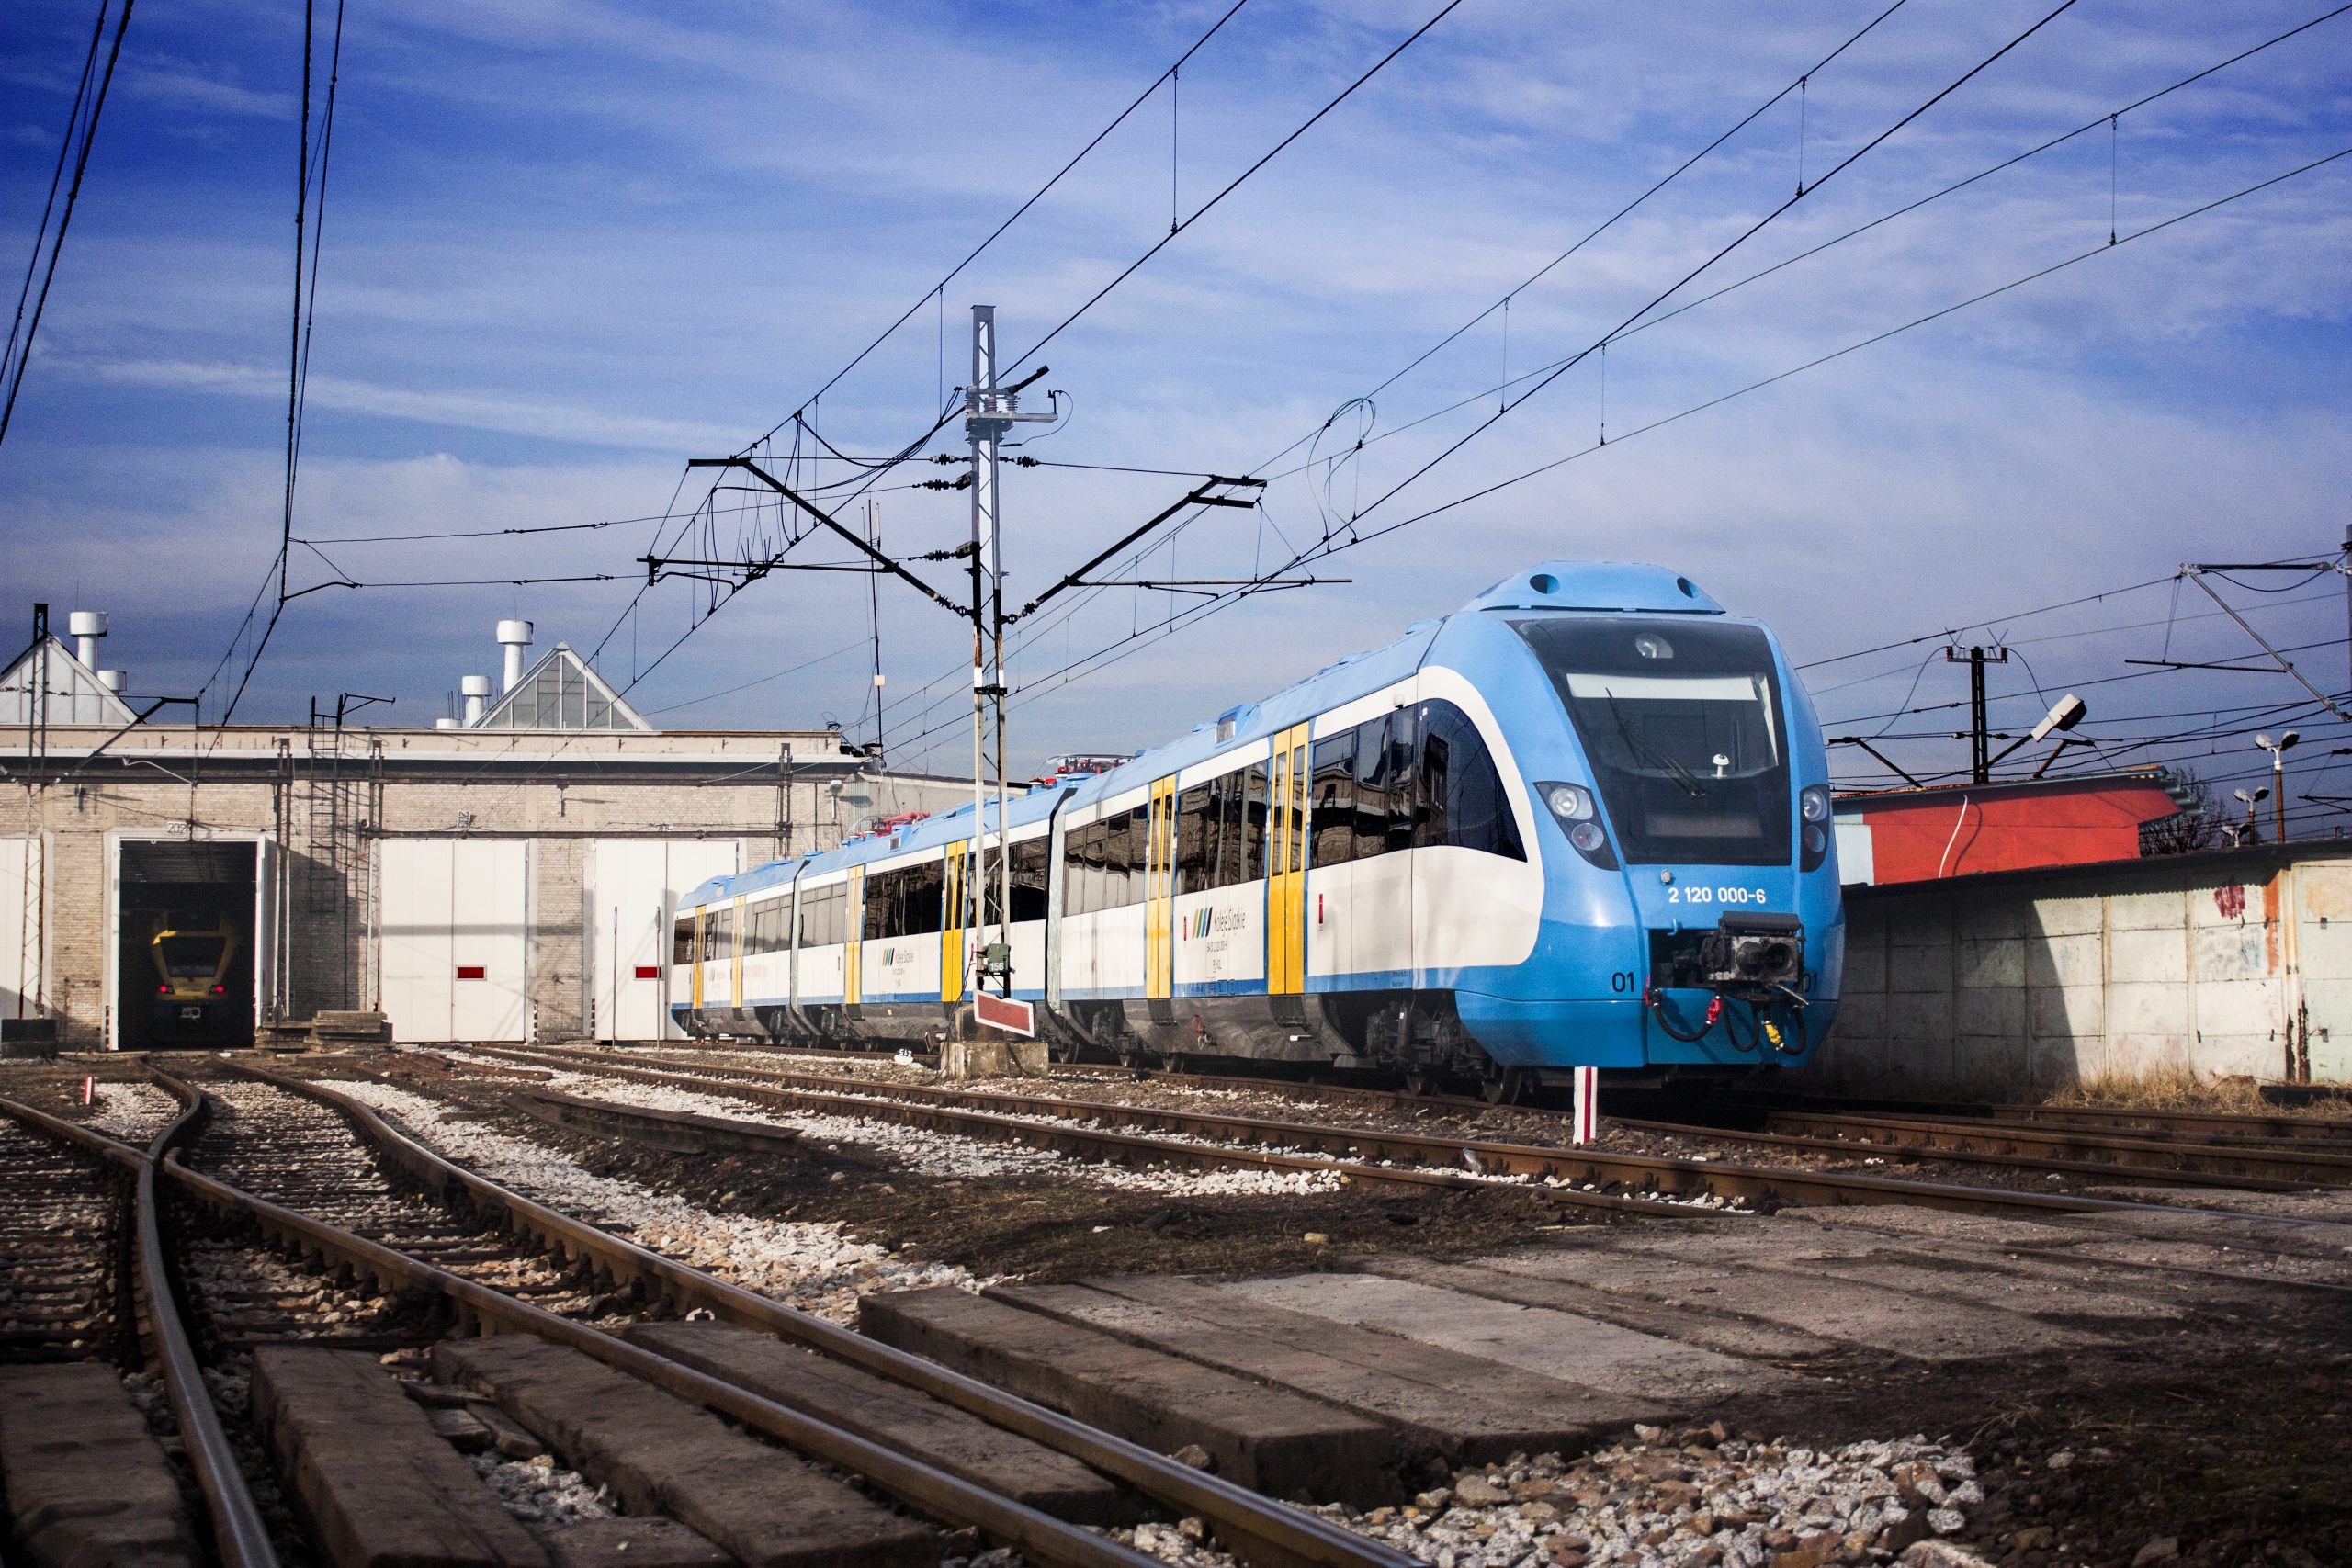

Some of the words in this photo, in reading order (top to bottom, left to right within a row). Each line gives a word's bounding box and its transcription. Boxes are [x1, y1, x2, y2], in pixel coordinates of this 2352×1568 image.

[167, 822, 187, 834] 202
[1668, 886, 1679, 903] 2
[1684, 886, 1713, 903] 120
[1717, 886, 1767, 904] 000-6
[989, 962, 1005, 971] 156
[1611, 971, 1634, 993] 01
